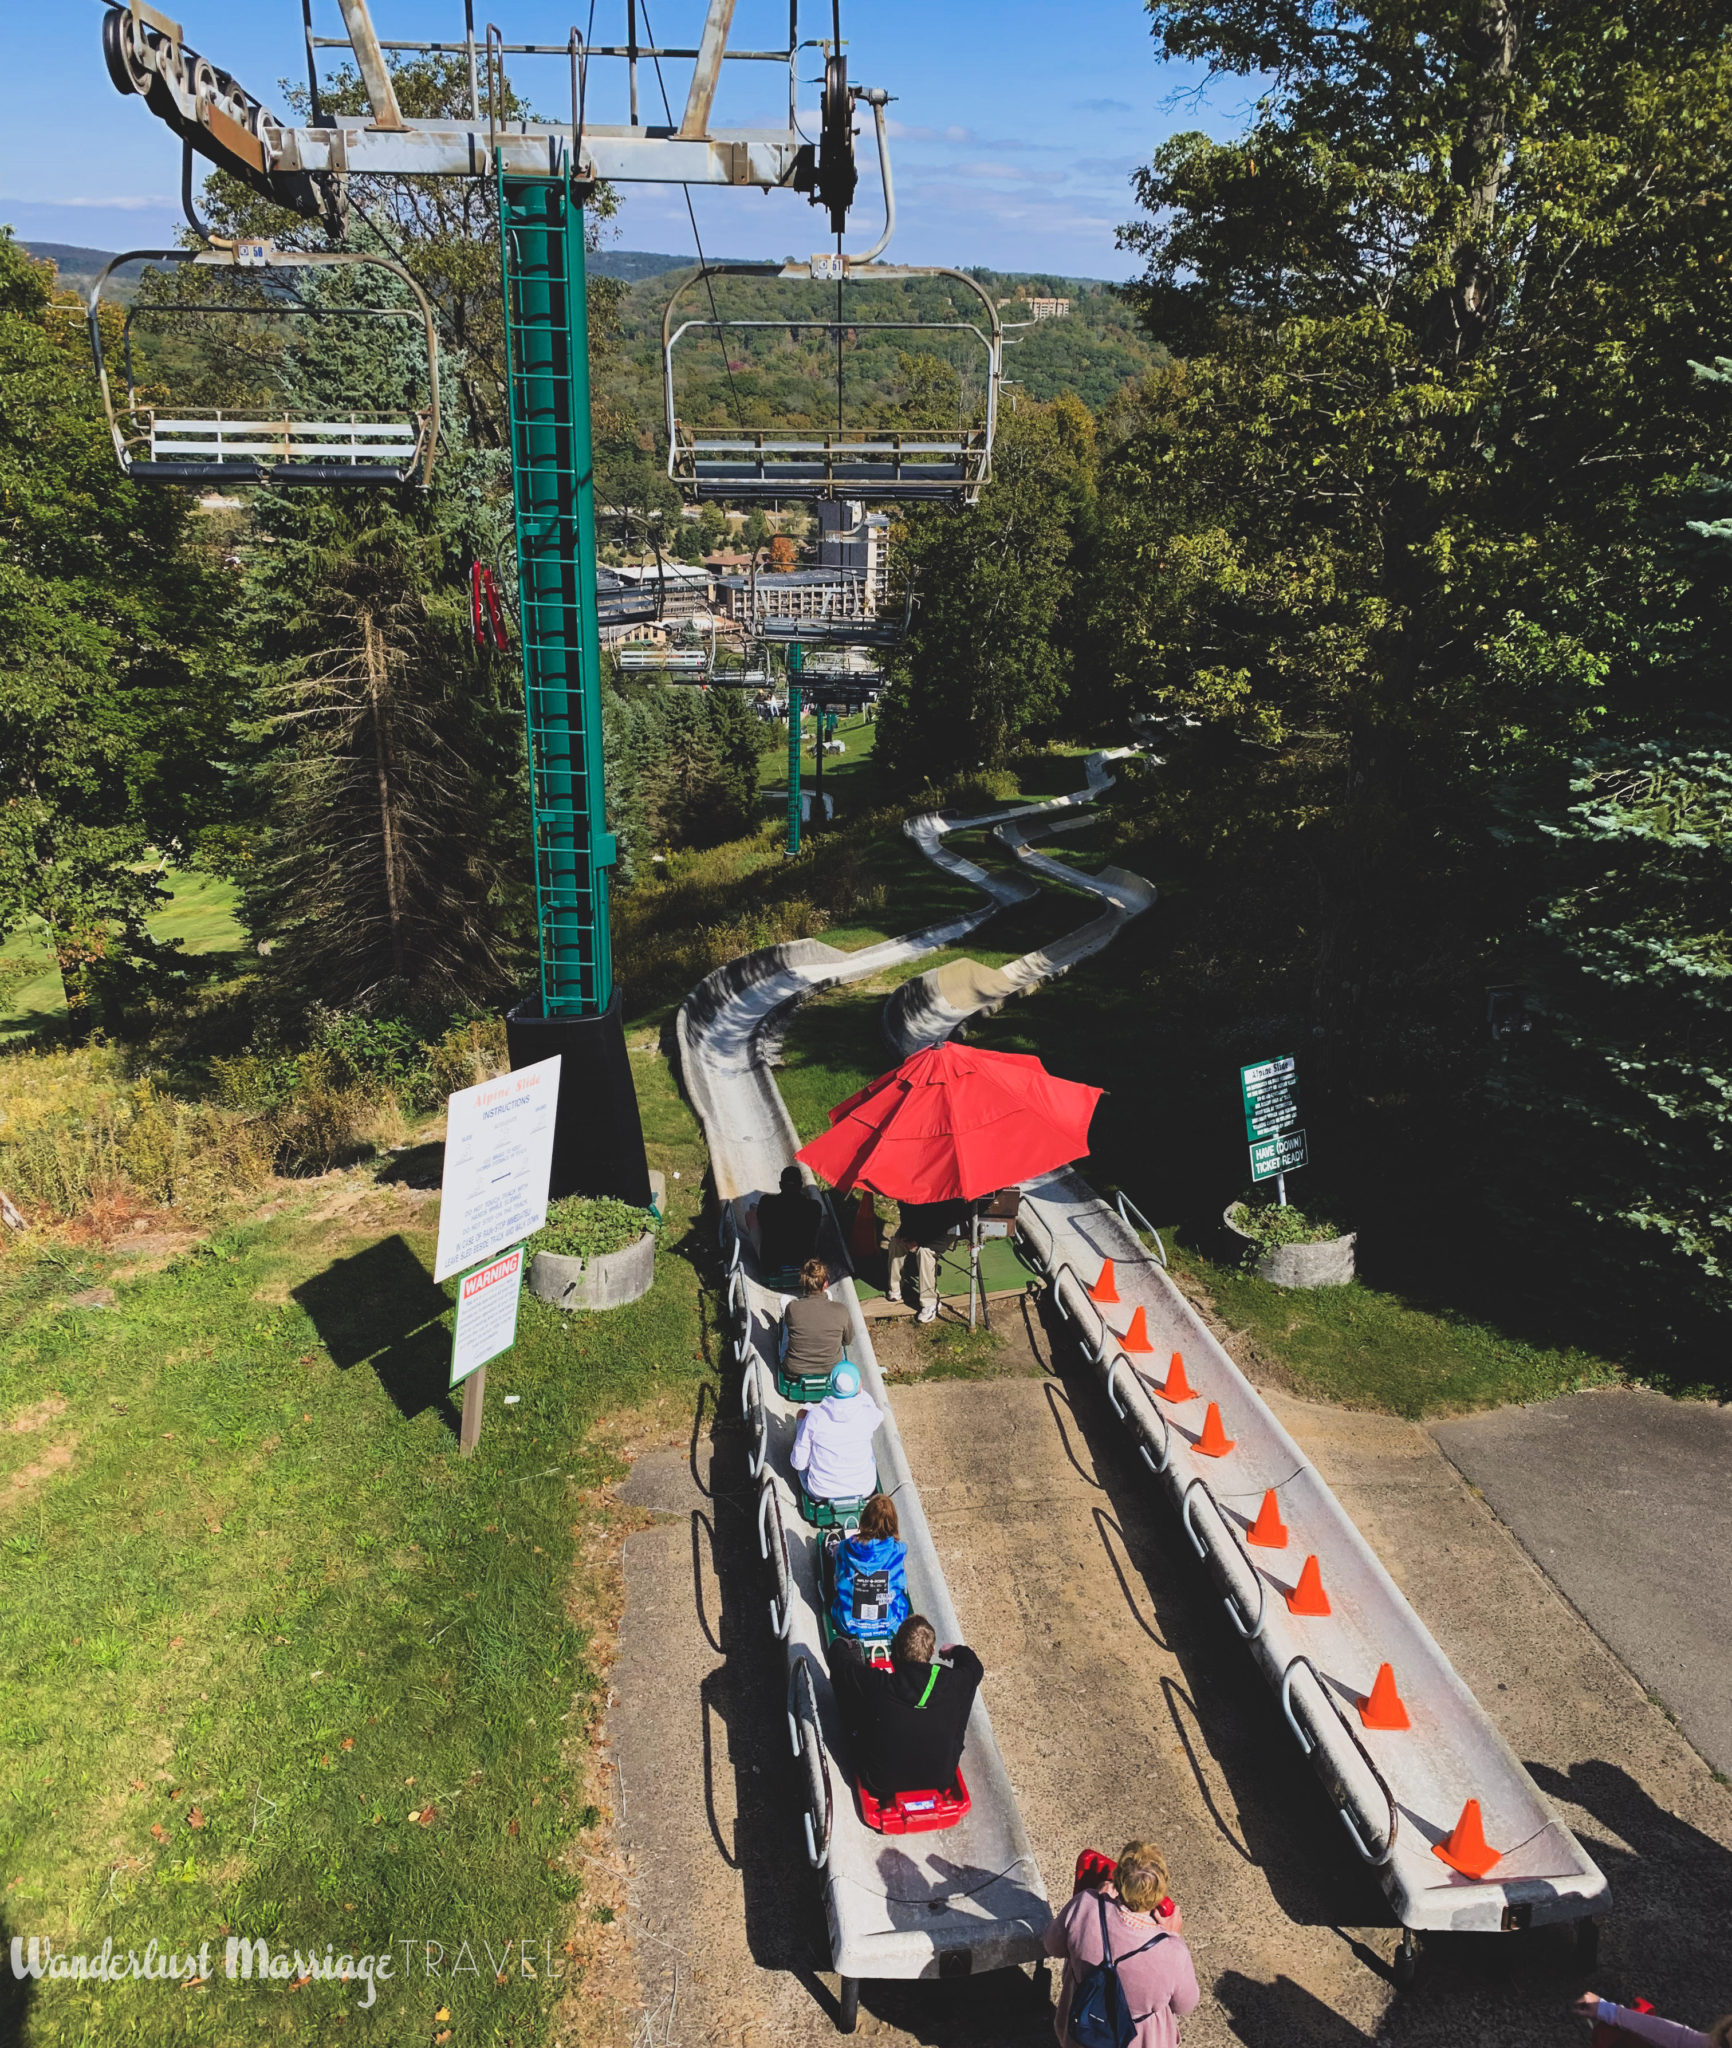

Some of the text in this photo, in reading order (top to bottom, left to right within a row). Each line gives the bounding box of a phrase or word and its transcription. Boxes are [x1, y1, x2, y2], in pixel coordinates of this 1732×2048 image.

[1252, 1061, 1289, 1079] Alpine Slide
[475, 1074, 541, 1108] Alpine Slide
[482, 1094, 531, 1120] INSTRUCTIONS
[1255, 1135, 1302, 1160] HAVE (DOWN)
[1255, 1149, 1304, 1174] TICKET READY
[444, 1254, 459, 1268] LEAVE
[460, 1248, 473, 1261] SLED
[473, 1240, 489, 1254] BESIDE
[490, 1232, 504, 1245] TRACK
[505, 1227, 515, 1238] AND
[462, 1235, 475, 1249] CASE
[465, 1255, 518, 1296] WARNING
